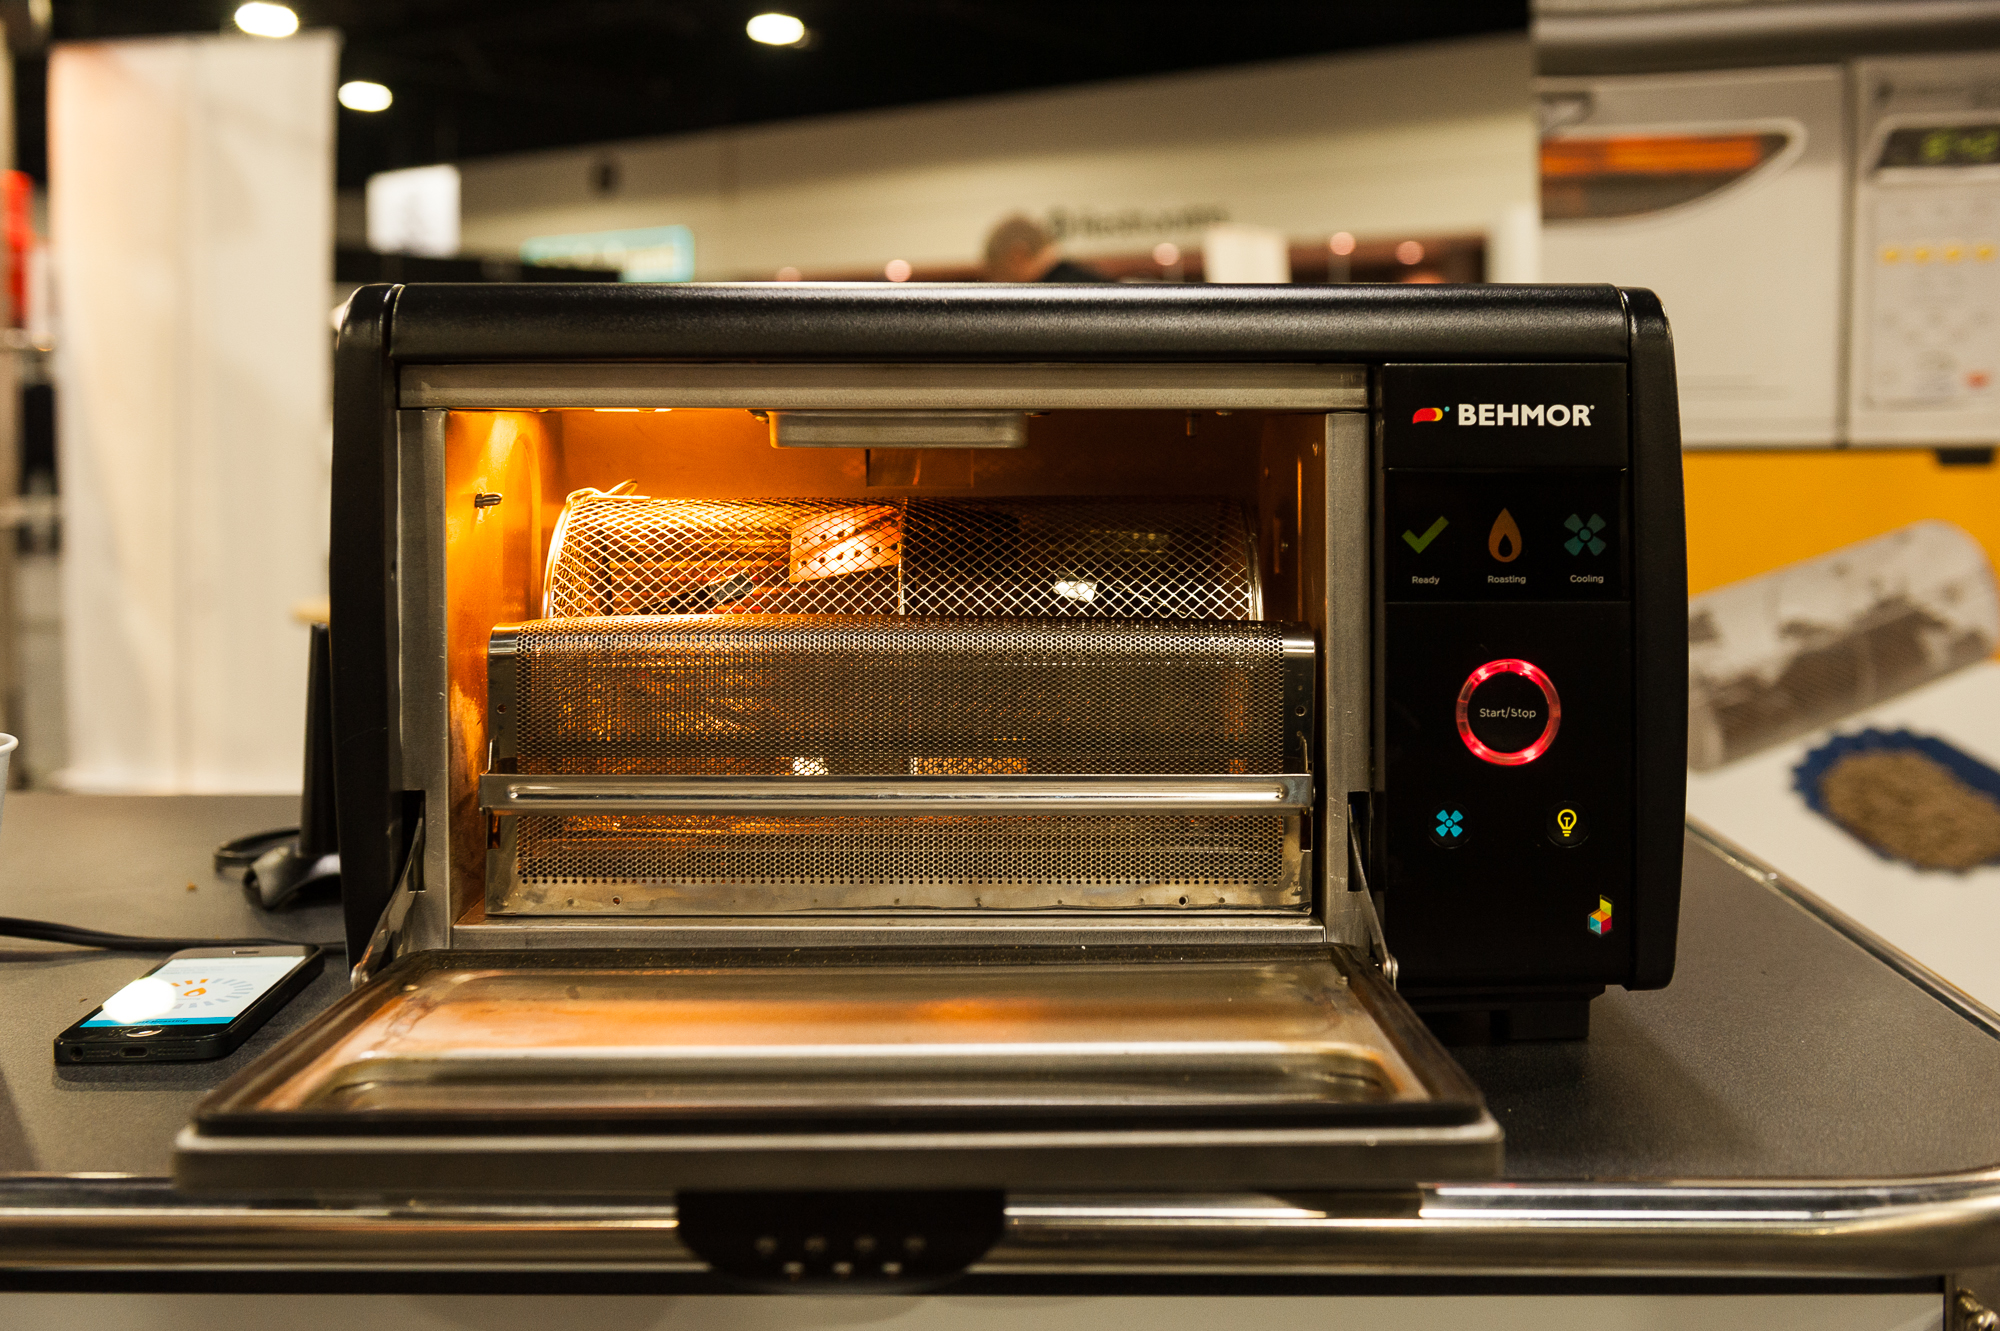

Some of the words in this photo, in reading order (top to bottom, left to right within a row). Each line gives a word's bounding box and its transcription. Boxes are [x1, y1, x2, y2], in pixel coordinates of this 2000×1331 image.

[1457, 403, 1592, 427] BEHMOR
[1411, 575, 1440, 586] Ready
[1487, 574, 1527, 585] Roasting
[1569, 574, 1604, 584] Cooling
[1479, 706, 1537, 719] Start/Stop
